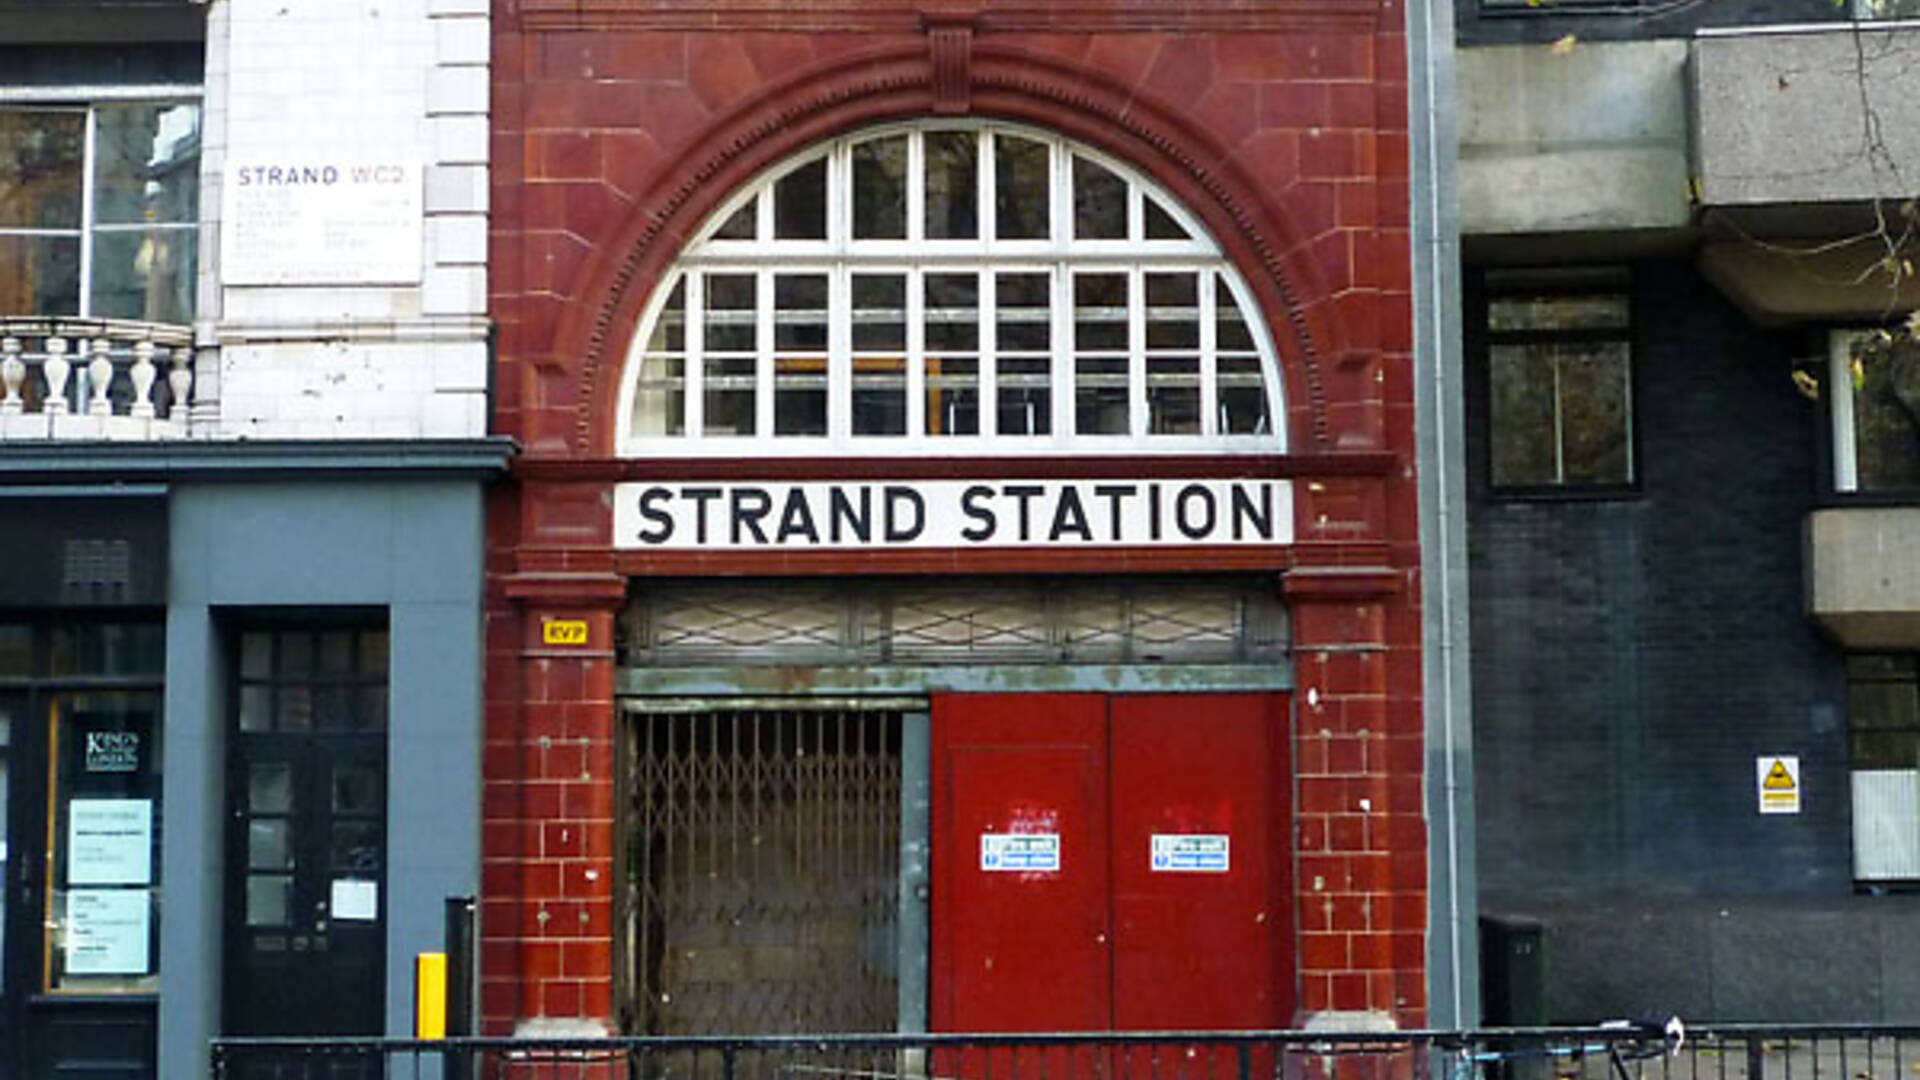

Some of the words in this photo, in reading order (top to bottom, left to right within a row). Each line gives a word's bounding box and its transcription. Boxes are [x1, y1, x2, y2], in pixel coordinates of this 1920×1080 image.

[238, 165, 338, 185] STRAND
[352, 165, 404, 184] WC2
[637, 484, 925, 544] STRAND
[960, 480, 1275, 544] STATION
[549, 625, 583, 640] RVP
